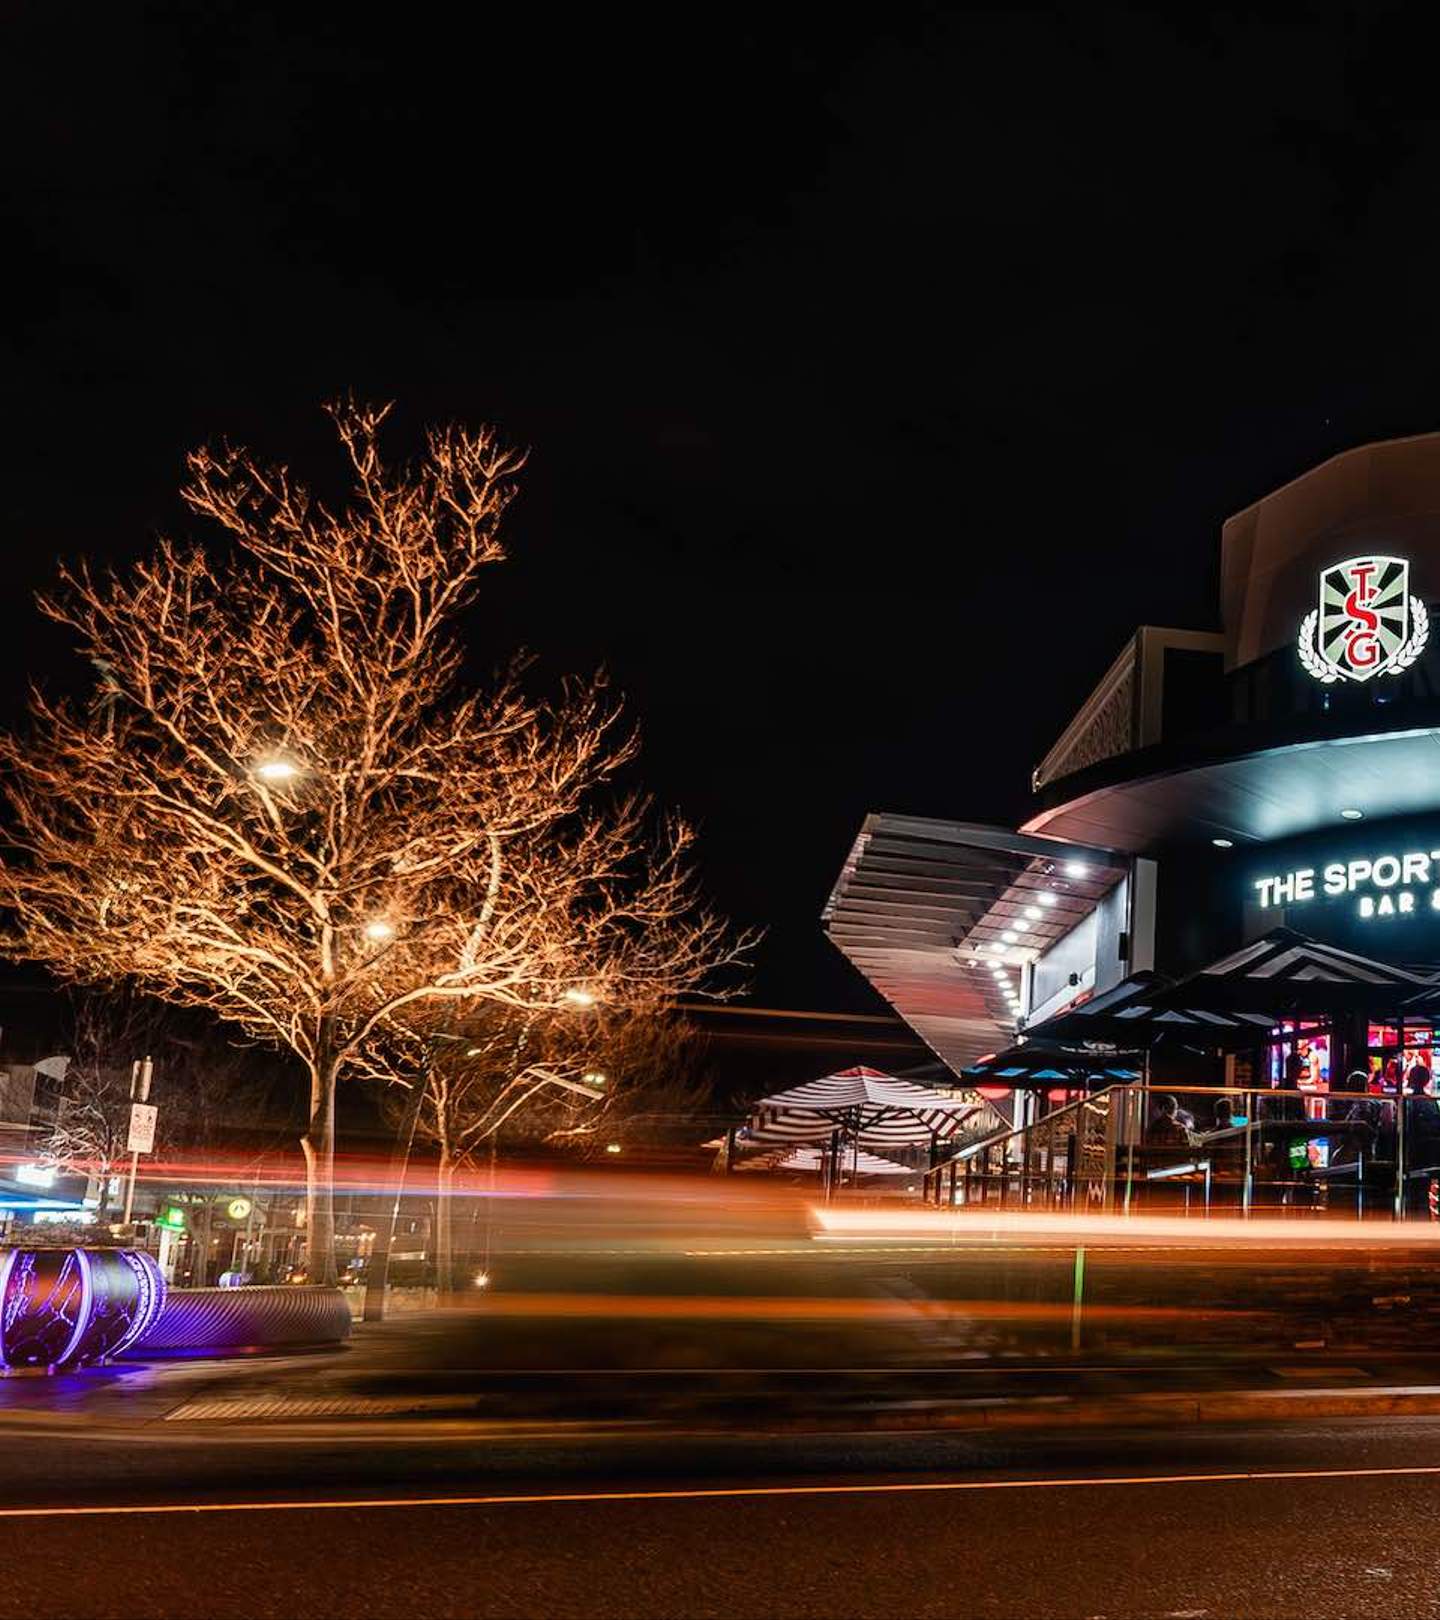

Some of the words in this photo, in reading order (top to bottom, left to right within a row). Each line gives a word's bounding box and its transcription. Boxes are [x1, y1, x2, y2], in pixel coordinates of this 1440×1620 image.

[1344, 564, 1381, 668] TSG
[1254, 868, 1315, 908] THE
[1358, 888, 1415, 918] BAR
